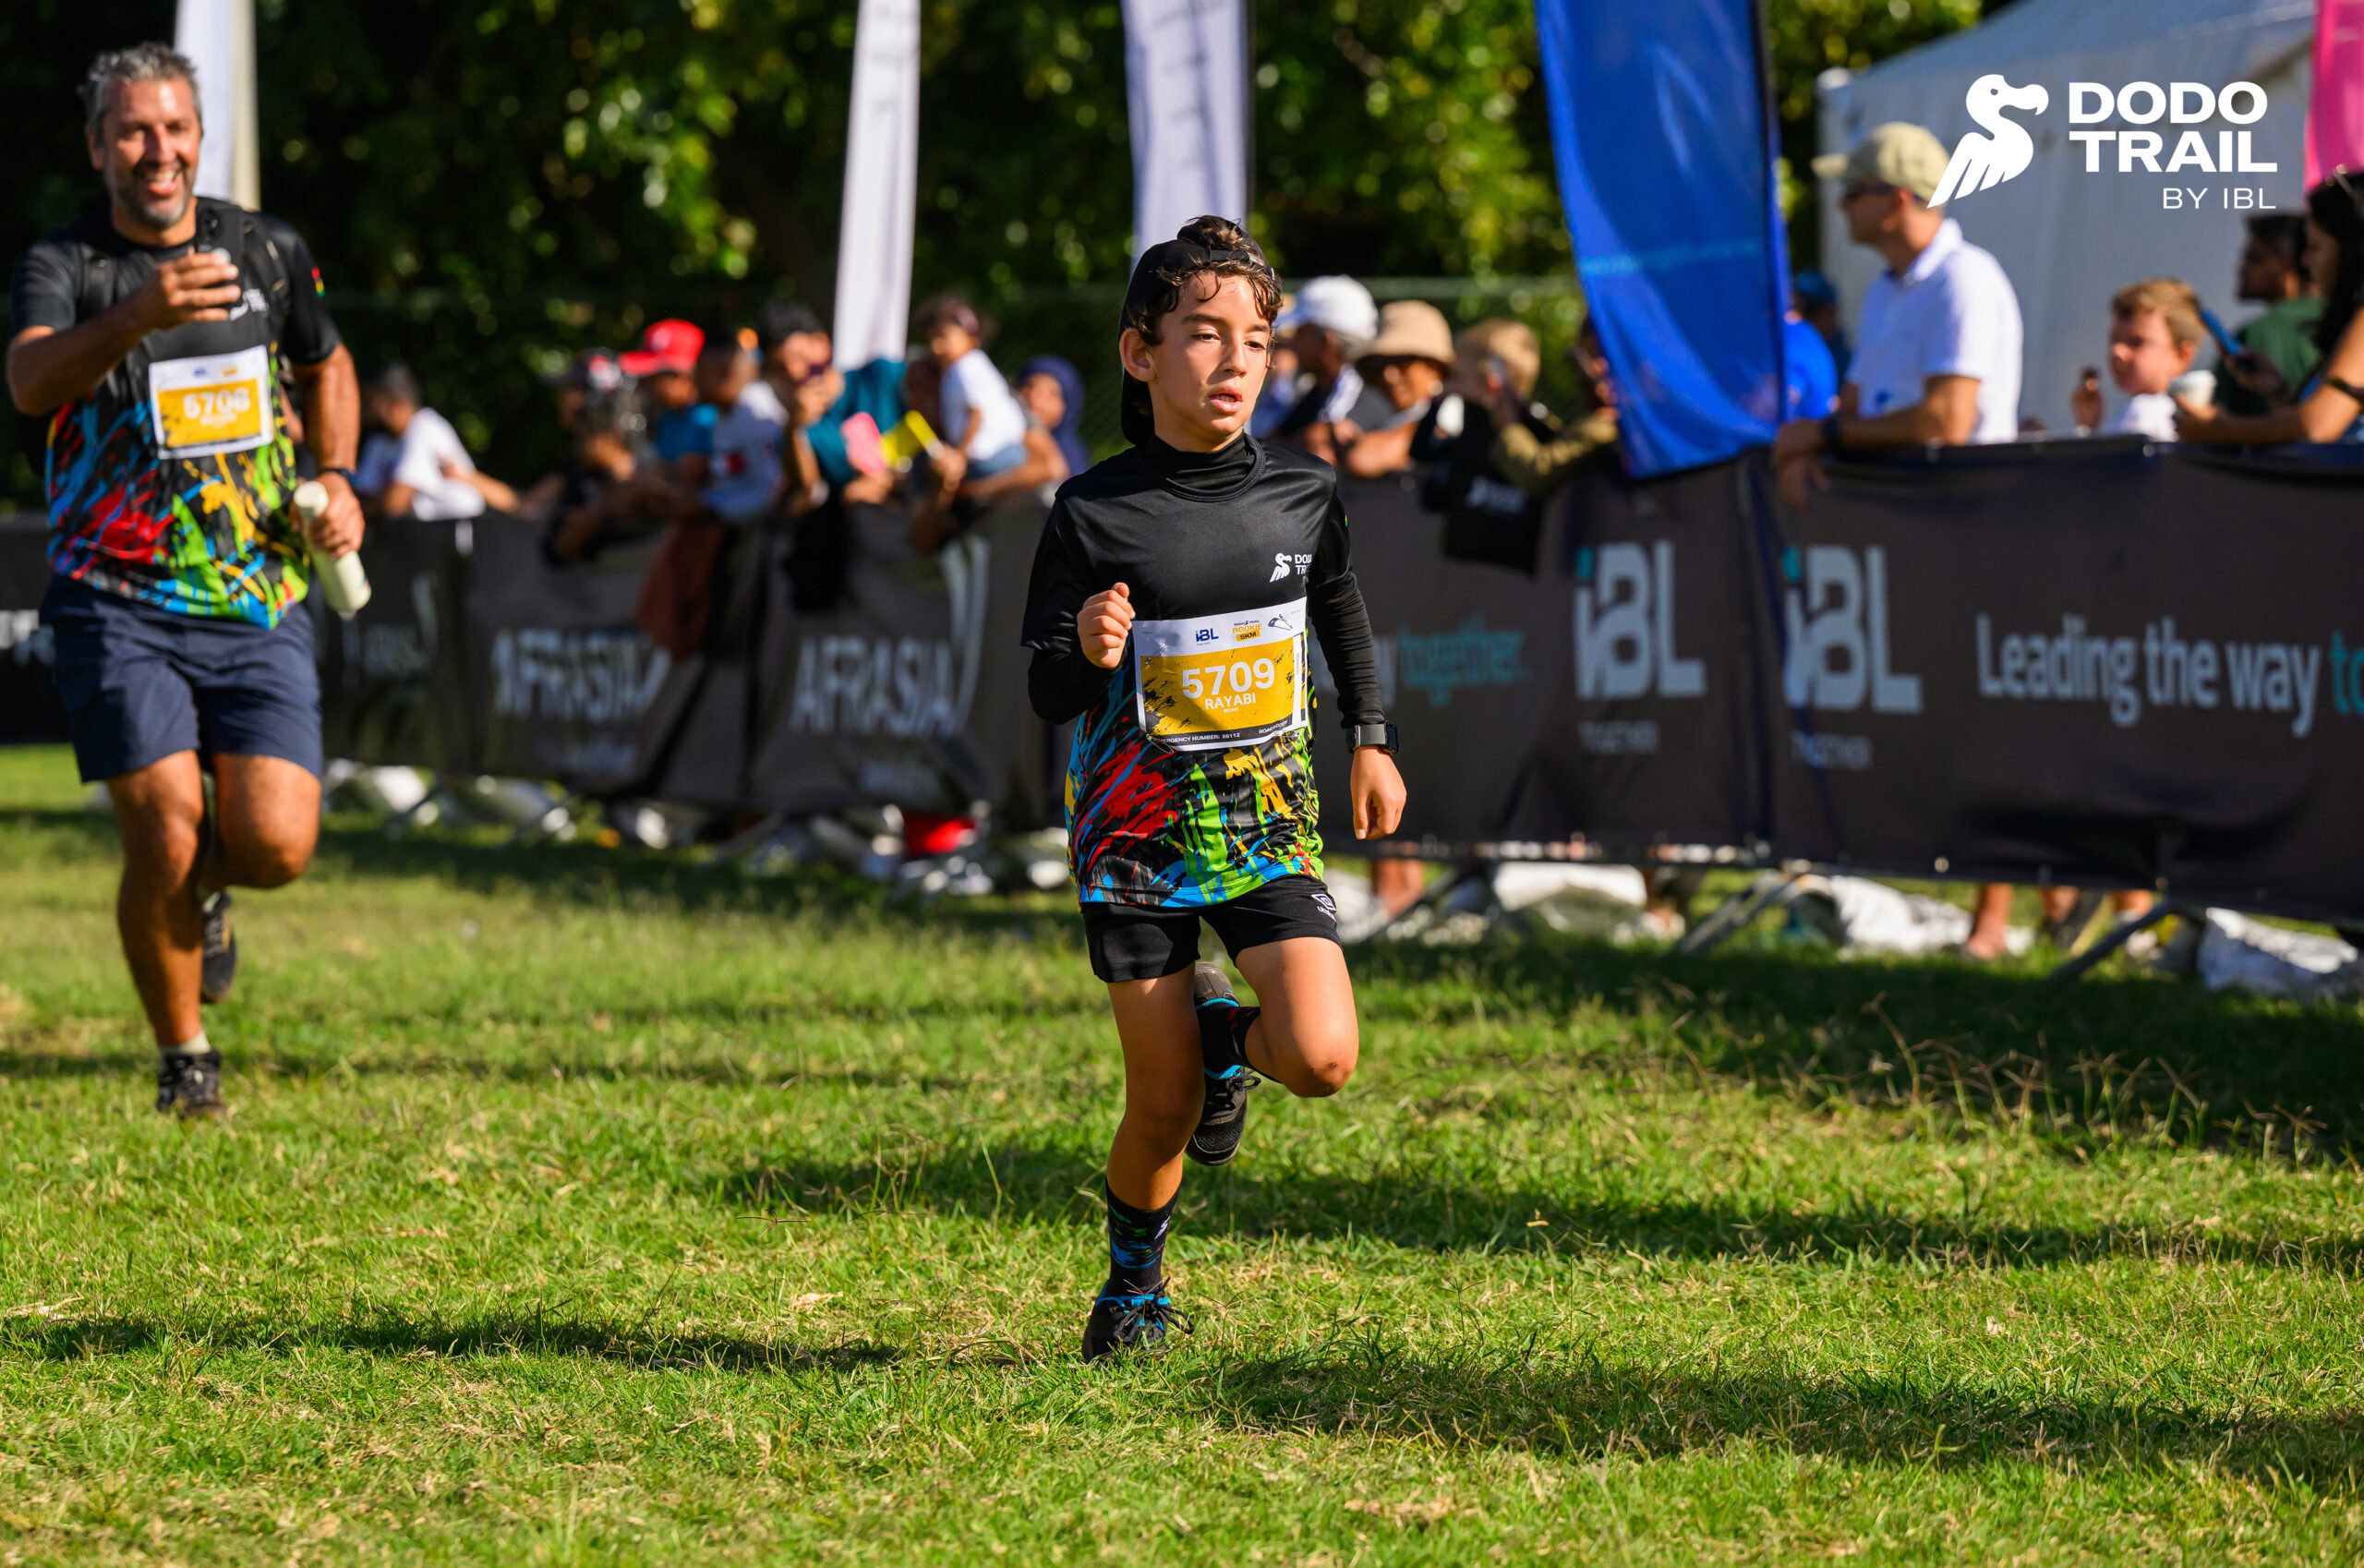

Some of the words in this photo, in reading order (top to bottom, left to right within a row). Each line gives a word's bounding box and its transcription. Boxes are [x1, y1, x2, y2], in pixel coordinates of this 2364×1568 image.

[1294, 554, 1312, 564] DO
[1232, 623, 1262, 633] ROOKIE
[1240, 632, 1257, 640] 5KM
[1182, 657, 1275, 699] 5709
[1974, 612, 2141, 728] Leading
[2143, 616, 2220, 707] the
[2225, 643, 2321, 738] way
[789, 635, 960, 737] AFRASIA
[1204, 693, 1257, 710] RAYABI
